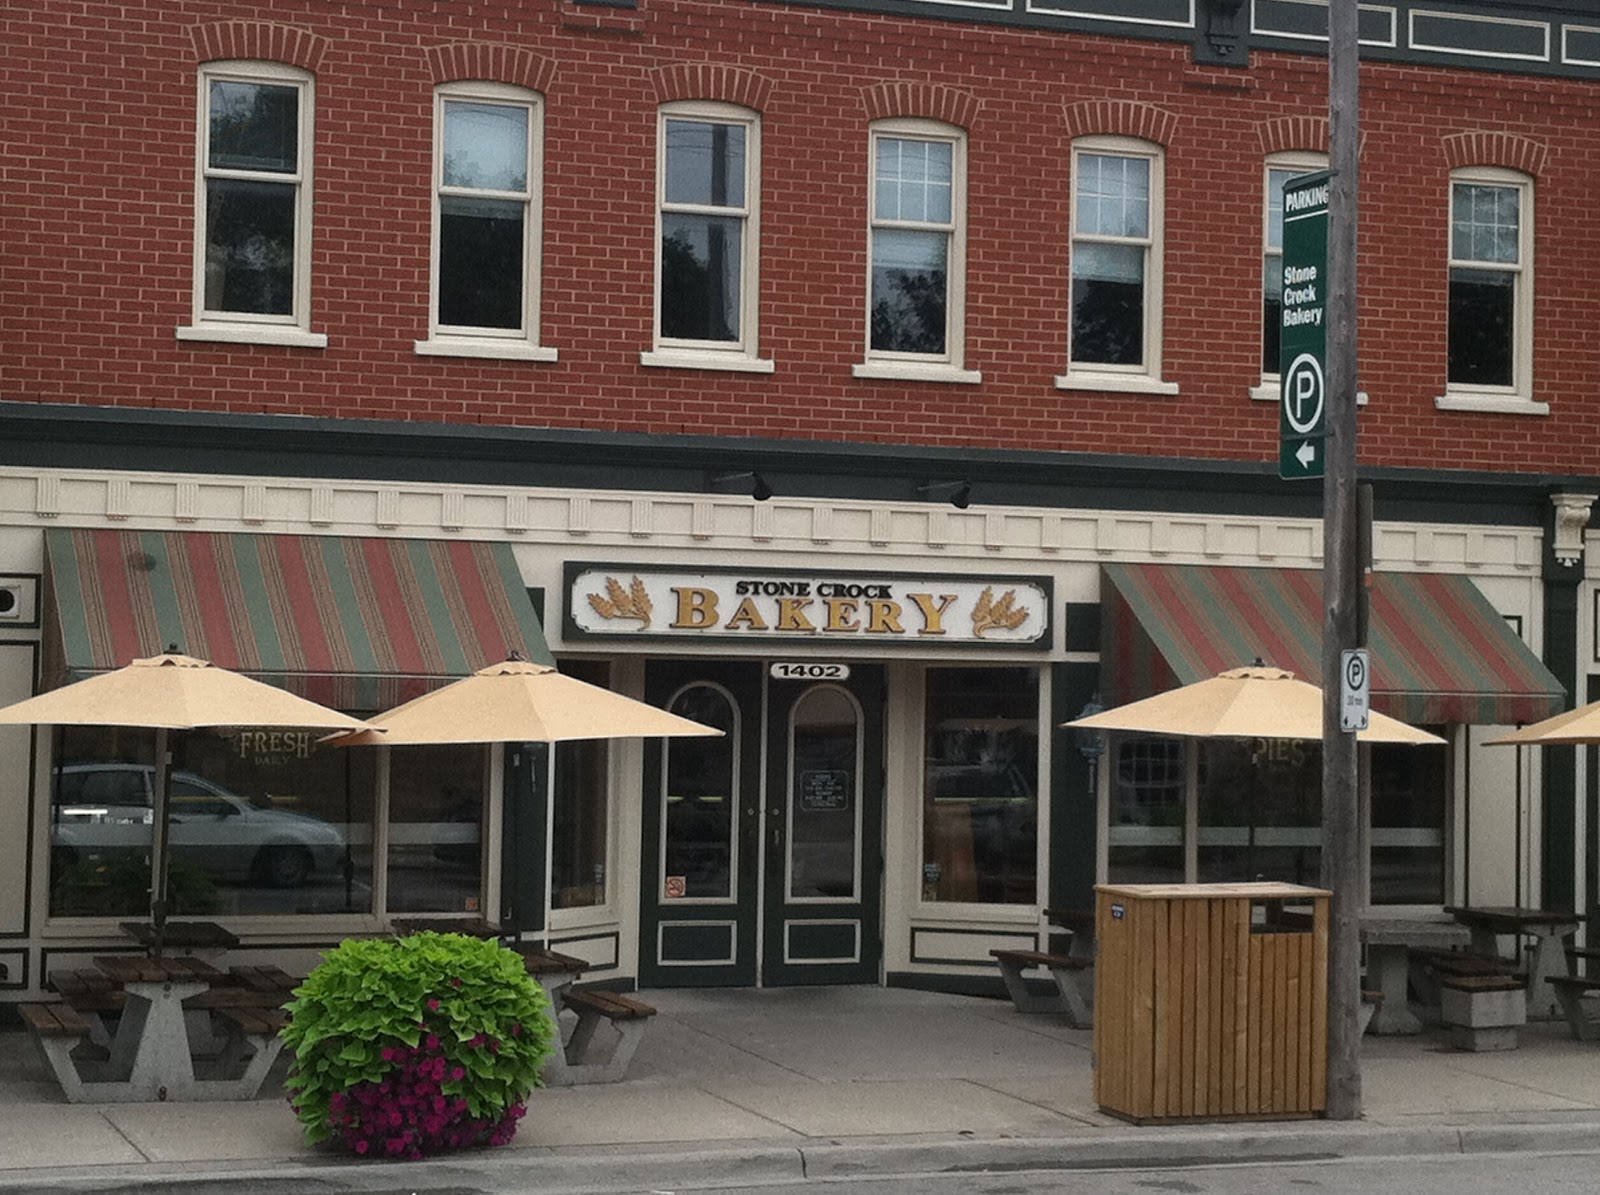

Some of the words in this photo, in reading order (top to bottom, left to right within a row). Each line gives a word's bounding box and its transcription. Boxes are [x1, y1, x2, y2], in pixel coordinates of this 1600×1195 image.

[1285, 184, 1329, 212] PARKING
[1284, 265, 1317, 285] Stone
[1284, 284, 1317, 306] Crock
[1283, 307, 1323, 327] Bakery
[1296, 370, 1315, 419] P
[735, 580, 811, 598] STONE
[816, 583, 893, 599] CROCK
[668, 586, 958, 635] BAKERY
[778, 664, 842, 679] 1402
[240, 731, 311, 759] FRESH
